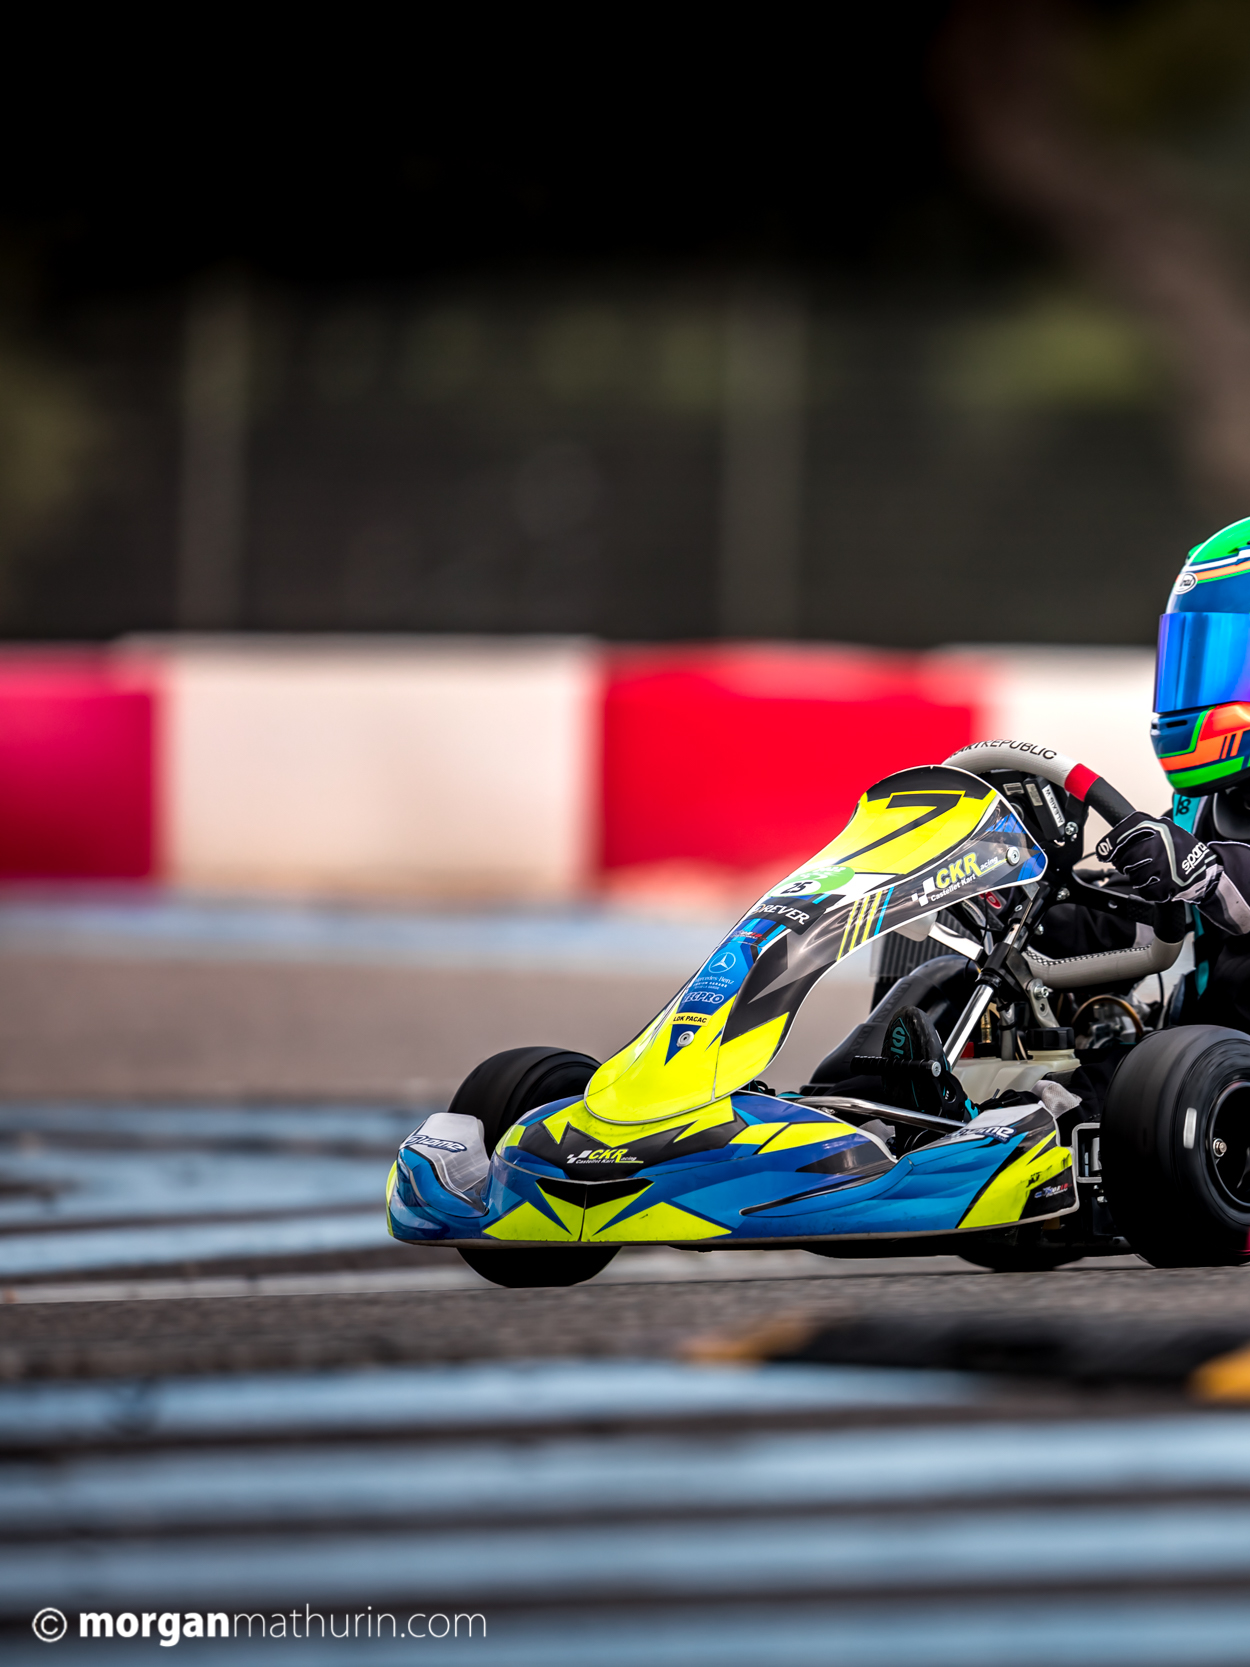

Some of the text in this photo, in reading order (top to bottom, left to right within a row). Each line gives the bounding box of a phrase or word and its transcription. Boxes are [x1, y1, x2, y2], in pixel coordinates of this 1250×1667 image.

[834, 793, 962, 865] 7
[936, 852, 981, 888] CKR
[780, 881, 813, 894] 25
[930, 882, 961, 902] Castellet
[961, 873, 976, 888] Kart
[588, 1149, 628, 1162] CKR
